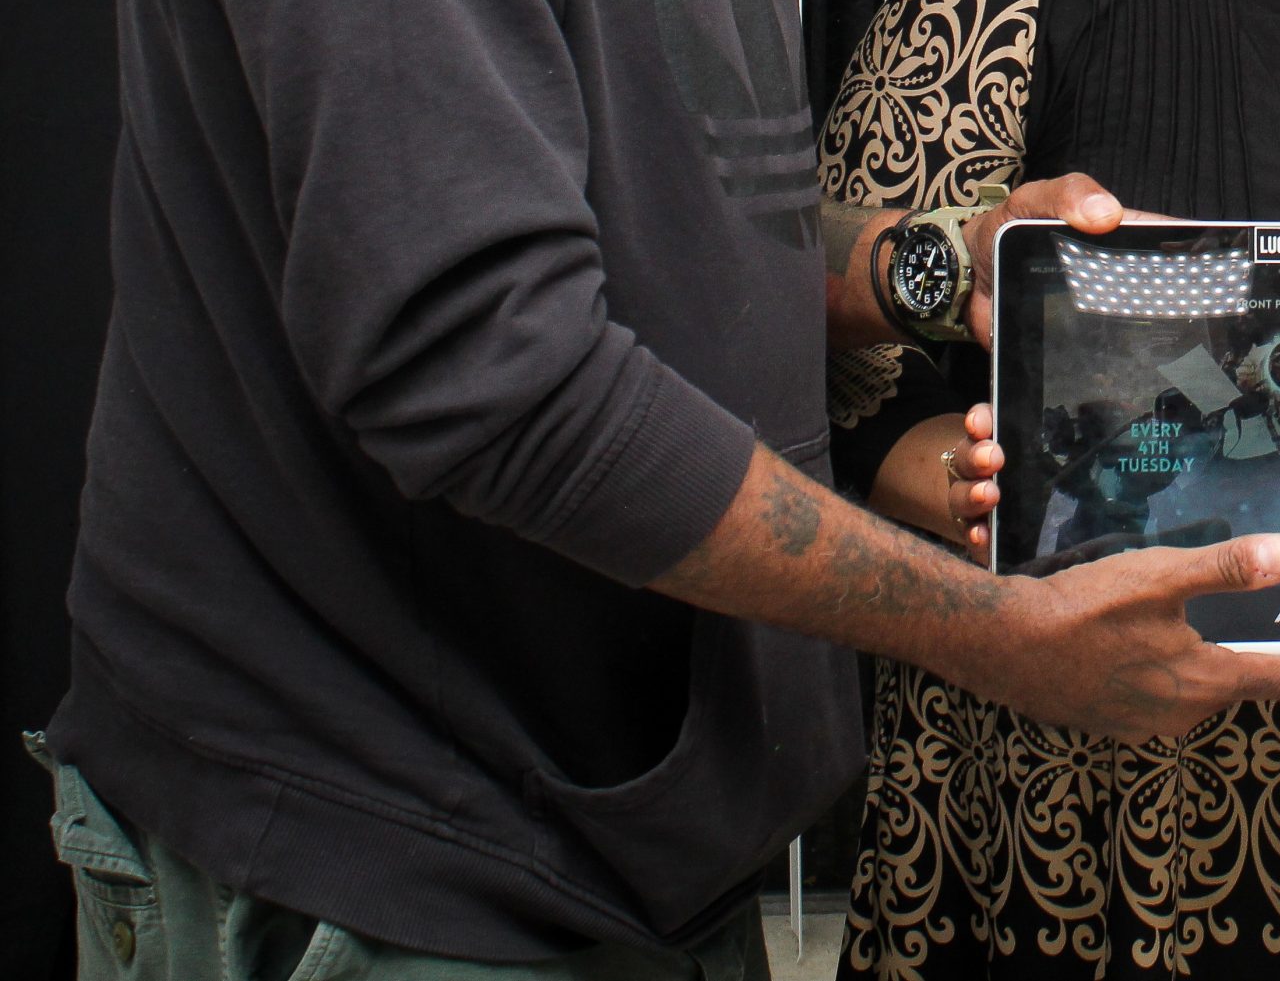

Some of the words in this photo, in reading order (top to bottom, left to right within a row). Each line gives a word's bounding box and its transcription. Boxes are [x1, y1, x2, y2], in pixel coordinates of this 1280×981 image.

[1130, 422, 1183, 438] EVERY
[1138, 440, 1169, 455] 4TH
[1118, 457, 1195, 473] TUESDAY
